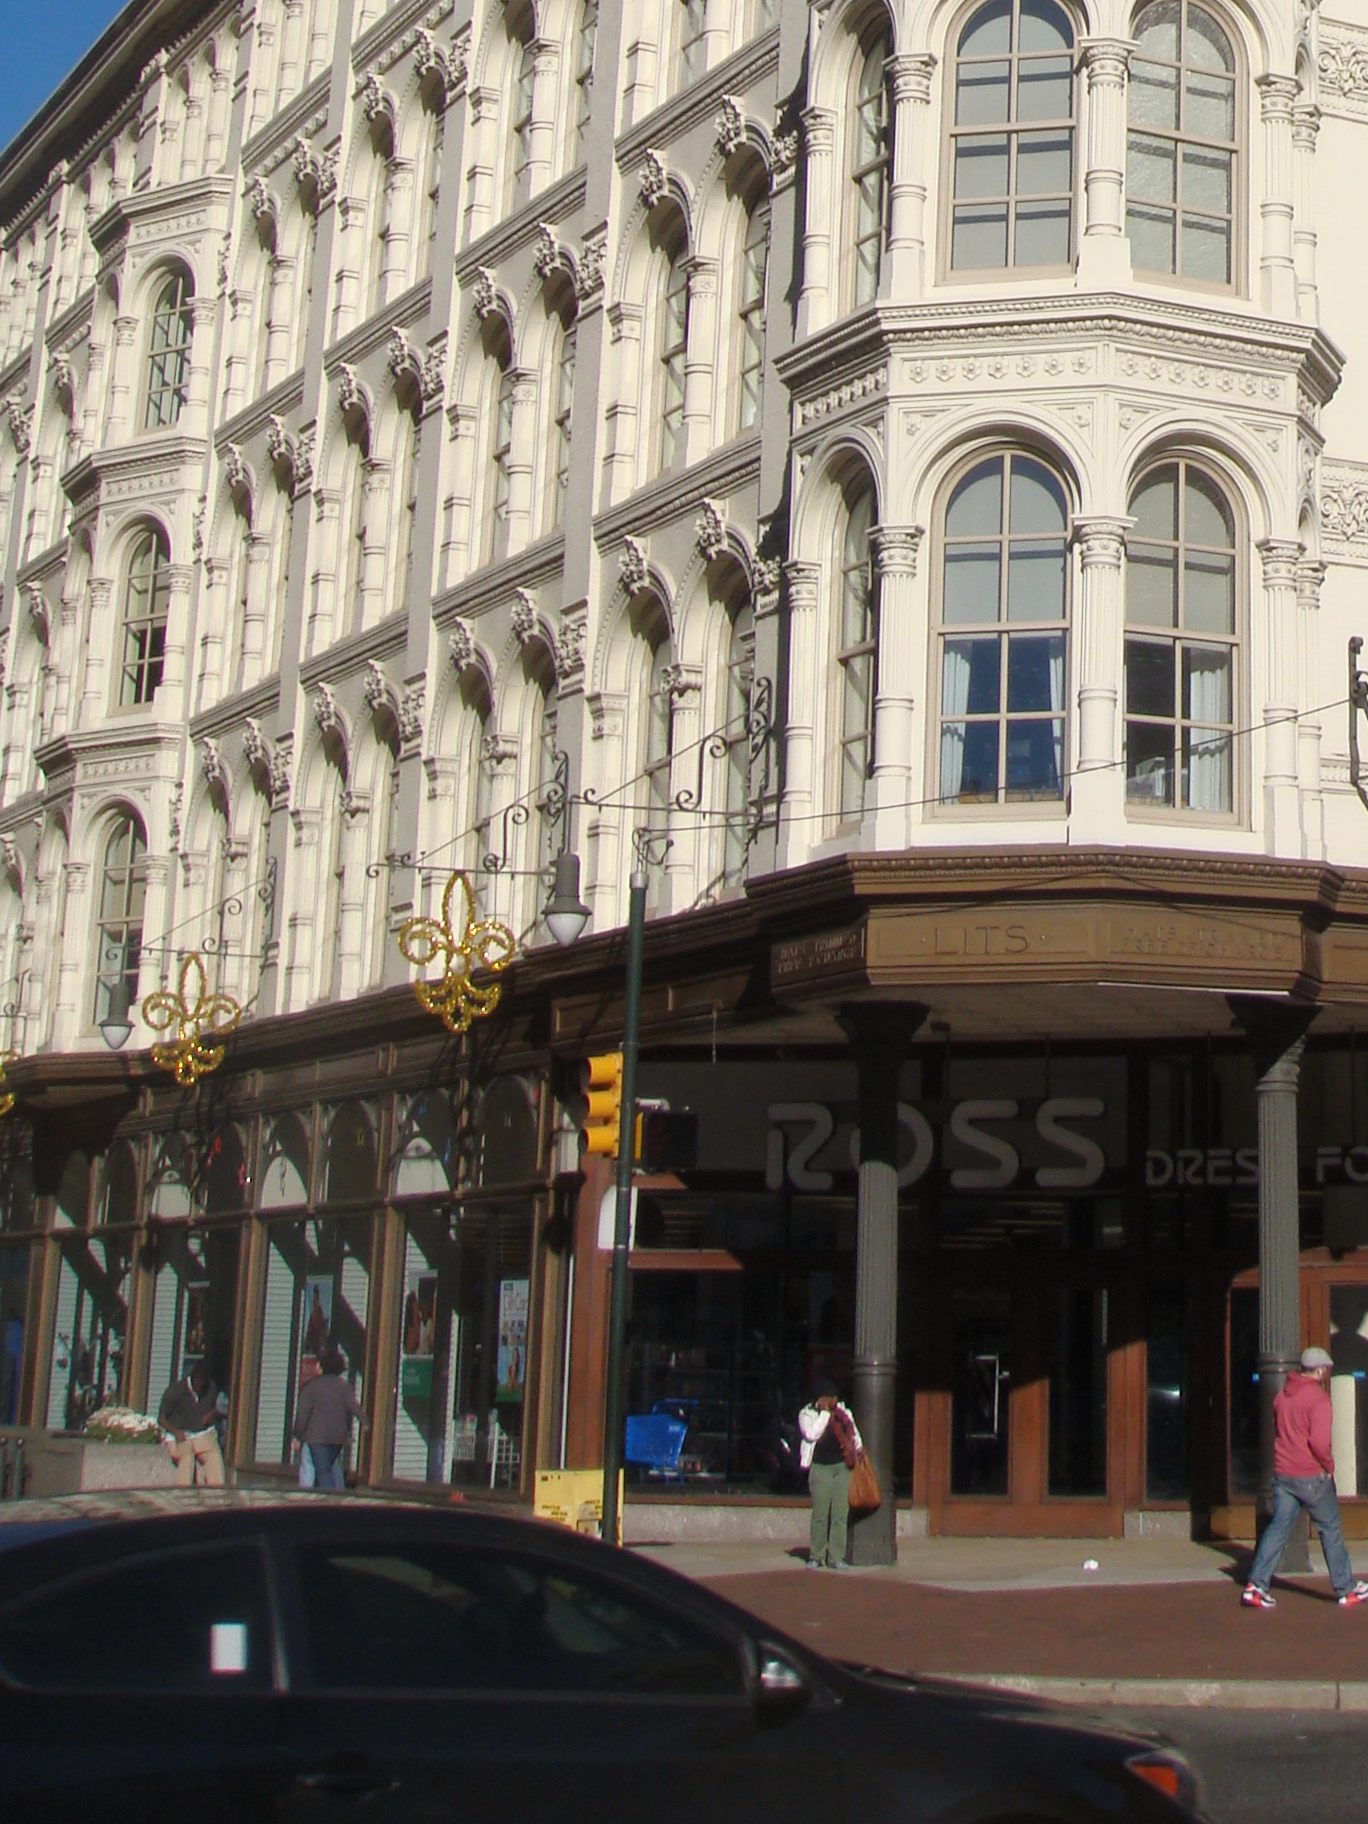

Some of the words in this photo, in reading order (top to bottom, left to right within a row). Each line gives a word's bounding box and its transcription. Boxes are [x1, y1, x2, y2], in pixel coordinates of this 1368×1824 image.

[934, 925, 1030, 955] LITS
[766, 1098, 1104, 1190] ROSS
[1146, 1148, 1259, 1186] DRES
